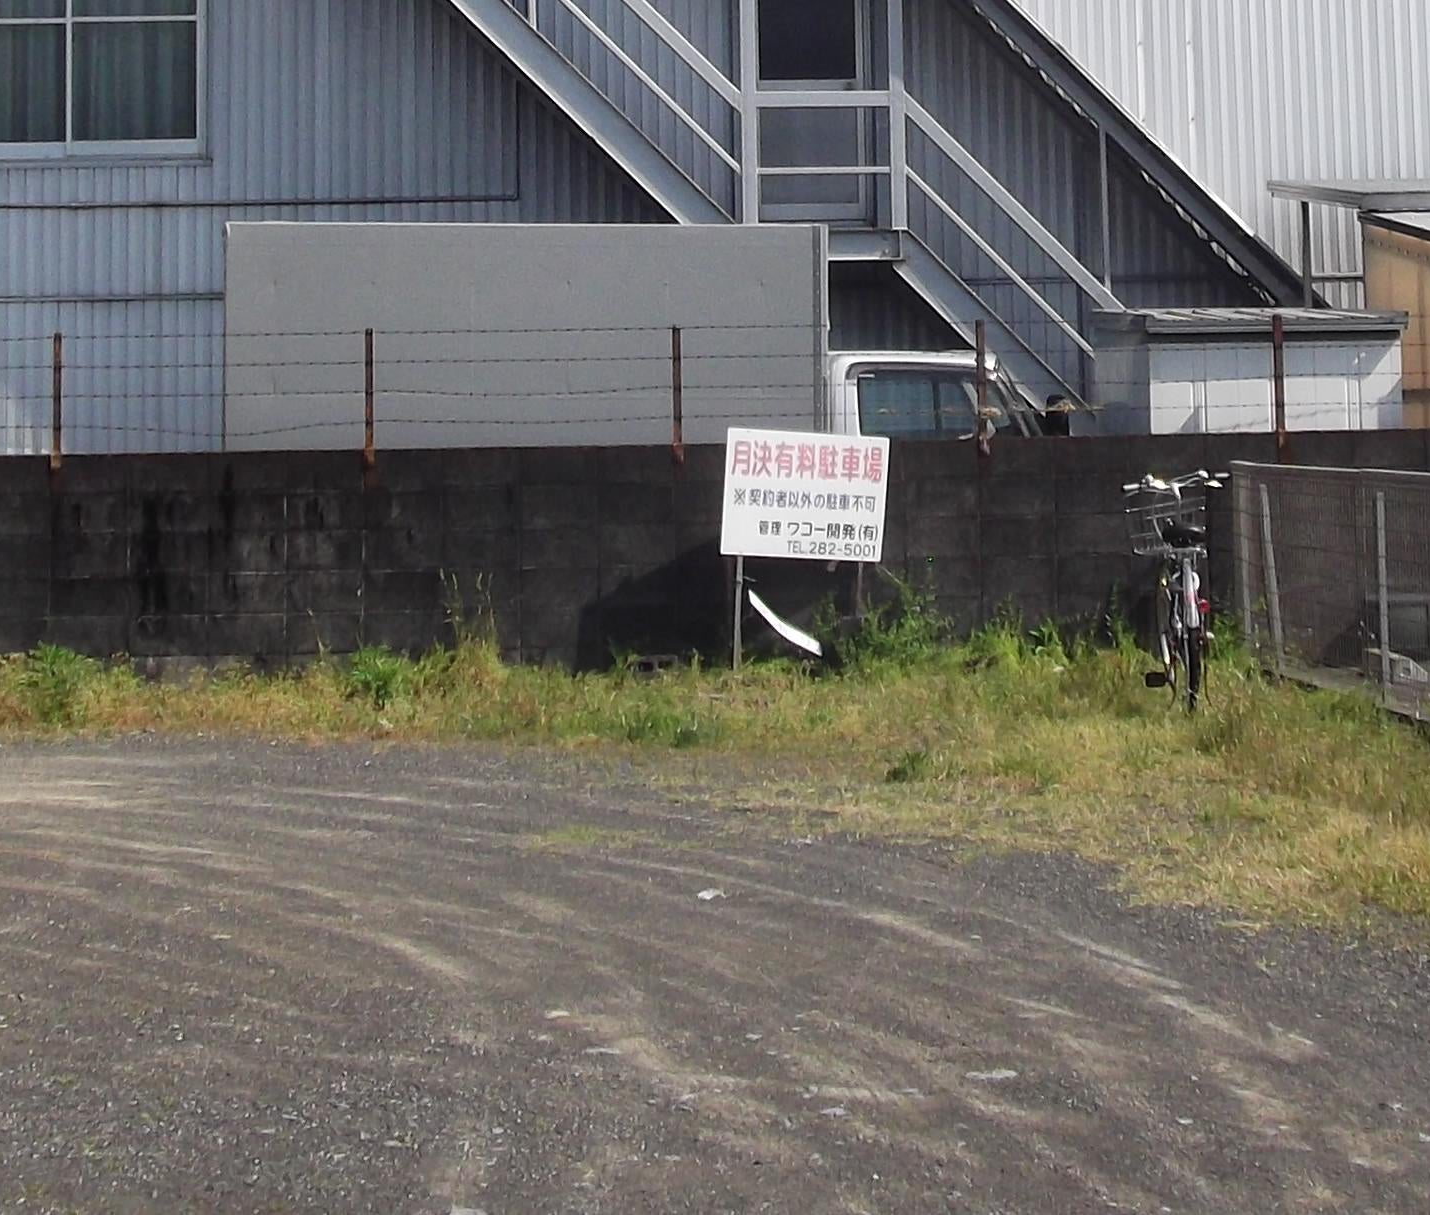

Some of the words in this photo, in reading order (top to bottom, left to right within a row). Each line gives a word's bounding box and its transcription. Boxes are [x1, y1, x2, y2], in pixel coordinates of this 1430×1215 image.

[731, 440, 883, 483] 月決有料駐車場
